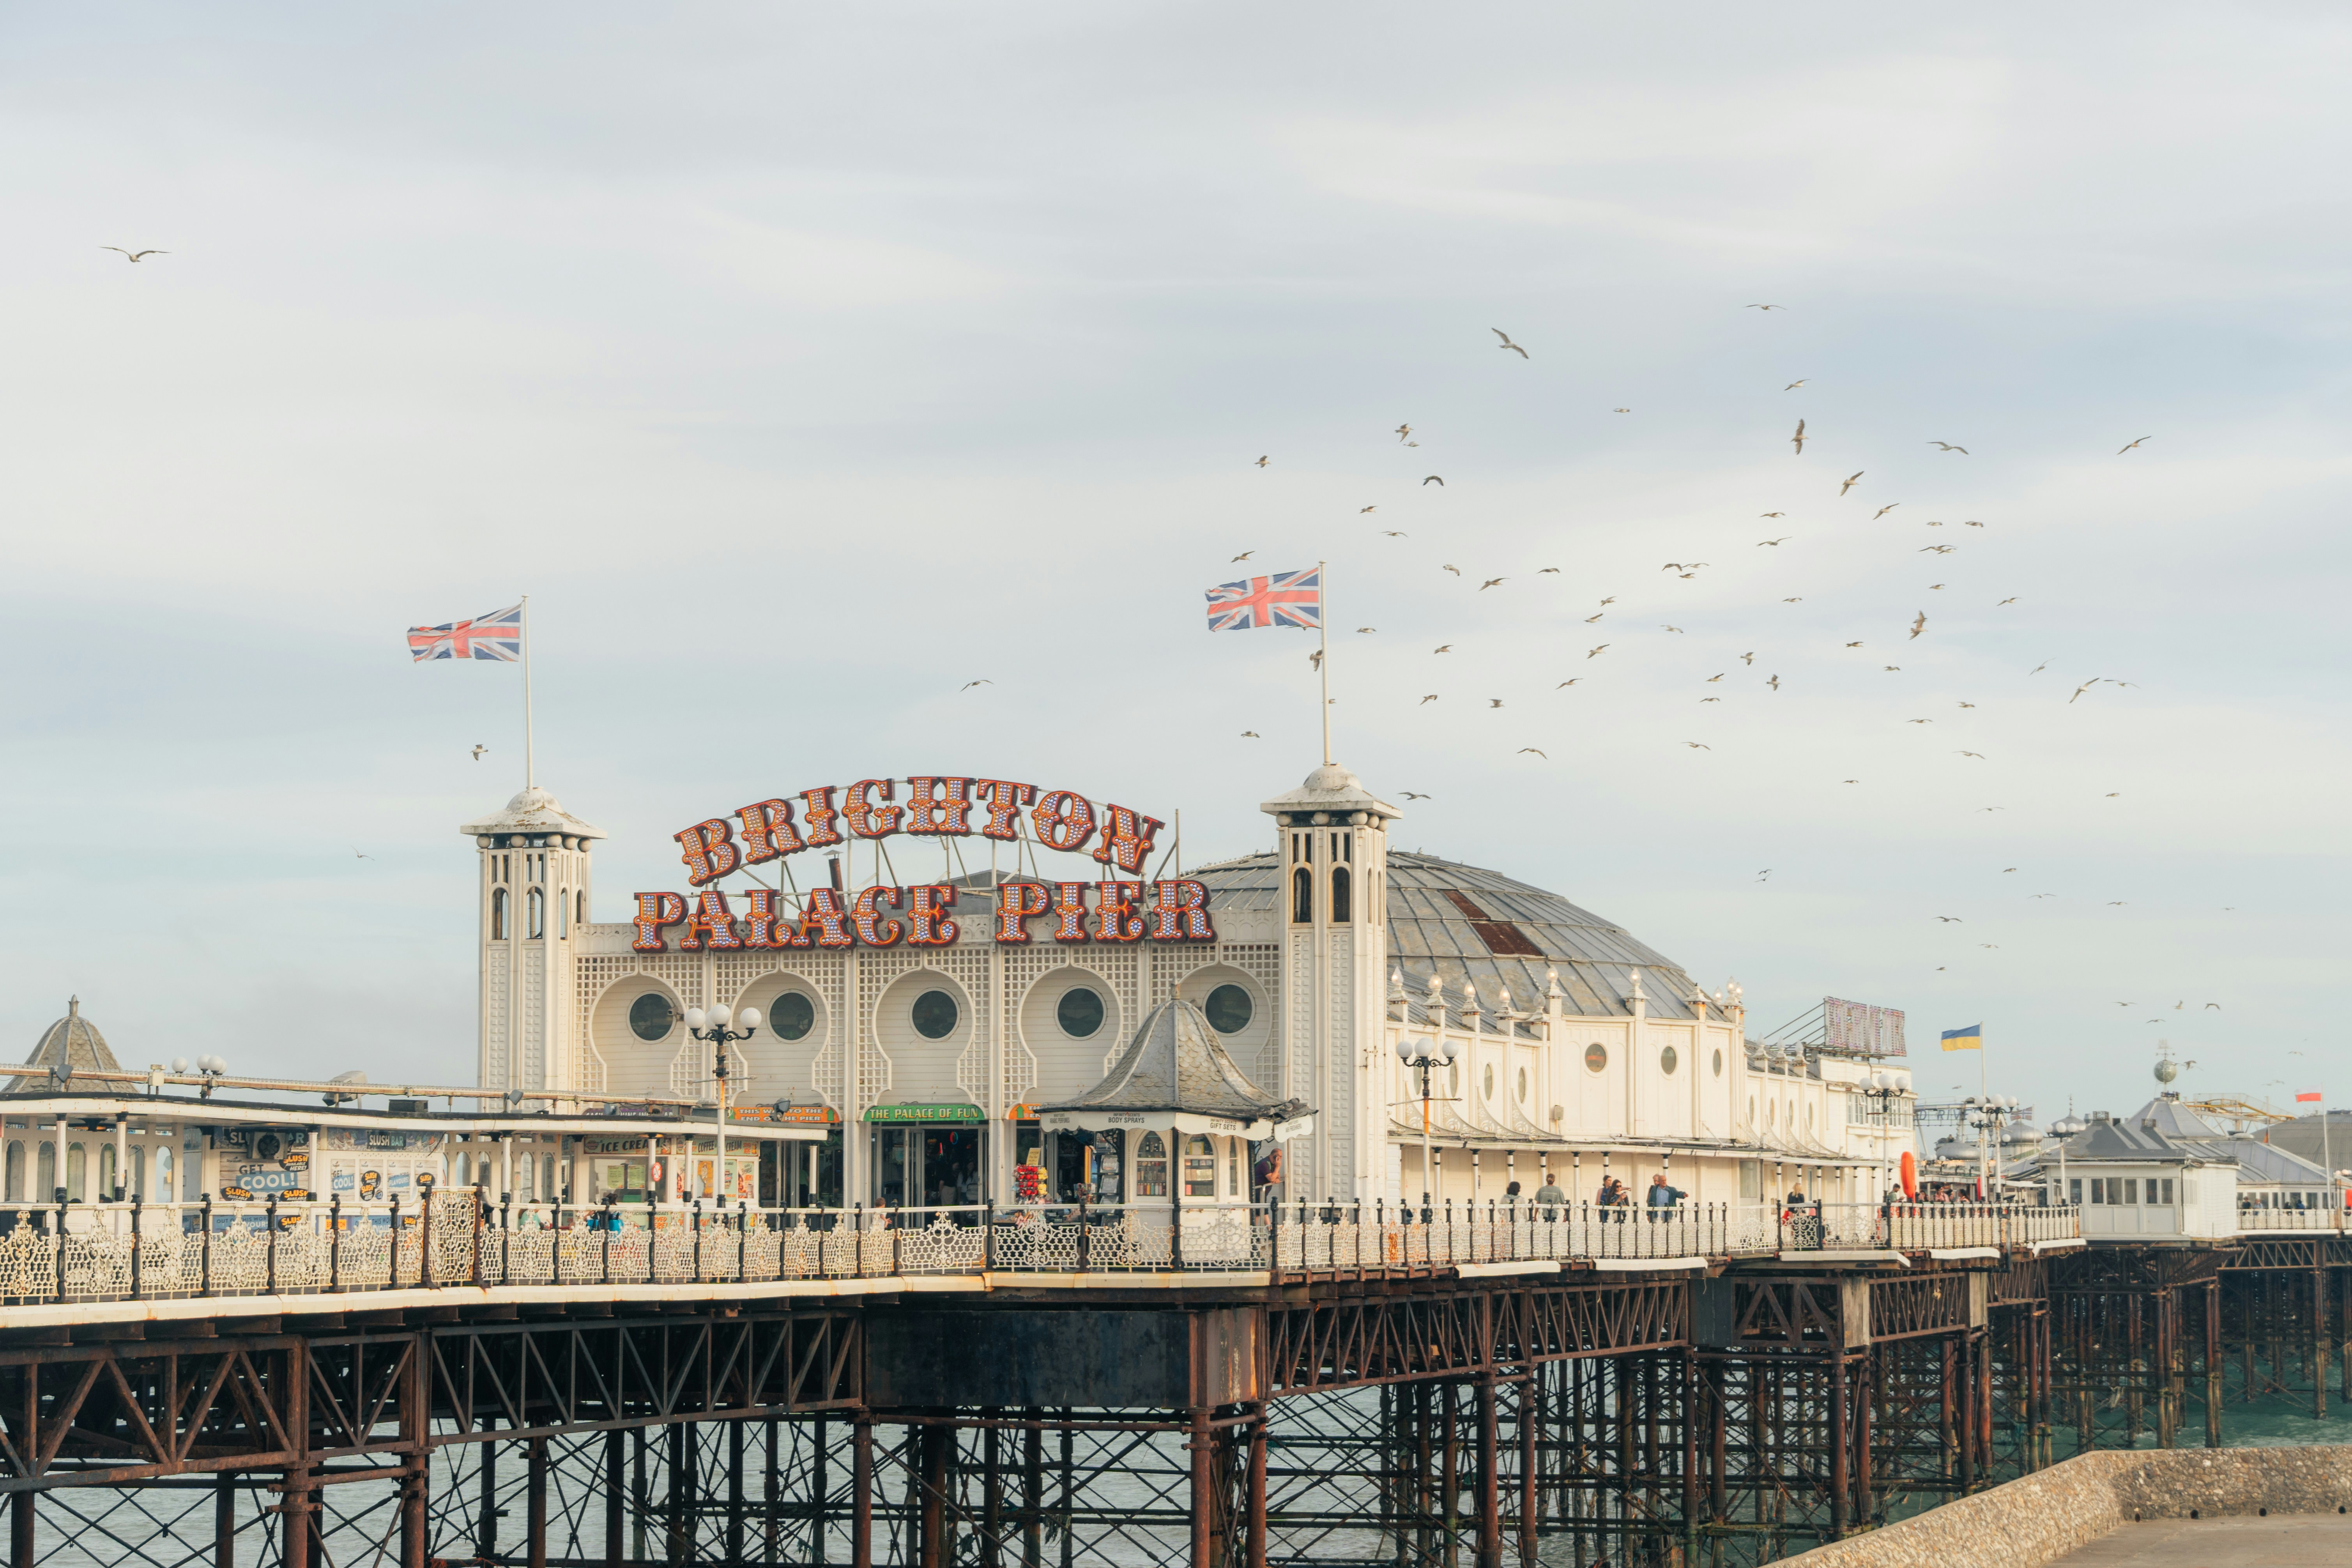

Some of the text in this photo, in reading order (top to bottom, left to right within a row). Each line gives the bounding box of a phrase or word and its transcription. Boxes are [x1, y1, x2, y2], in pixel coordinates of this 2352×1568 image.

[673, 776, 1165, 887] BRIGHTON
[632, 880, 1218, 953] PALACE PIER
[870, 1108, 978, 1119] THE PALACE OF FUN
[369, 1135, 403, 1146] SLUSH BAR
[600, 1142, 619, 1153] ICE
[698, 1140, 714, 1153] COFFEE
[726, 1140, 742, 1152] CREAM
[239, 1164, 264, 1175] GET
[240, 1173, 295, 1190] COOL!
[364, 1172, 377, 1181] SLUSH
[419, 1174, 432, 1183] SLUSH
[333, 1176, 354, 1189] COOL!
[225, 1187, 251, 1198] SLUSH
[361, 1184, 373, 1193] SLUSH
[281, 1216, 301, 1226] SLUS
